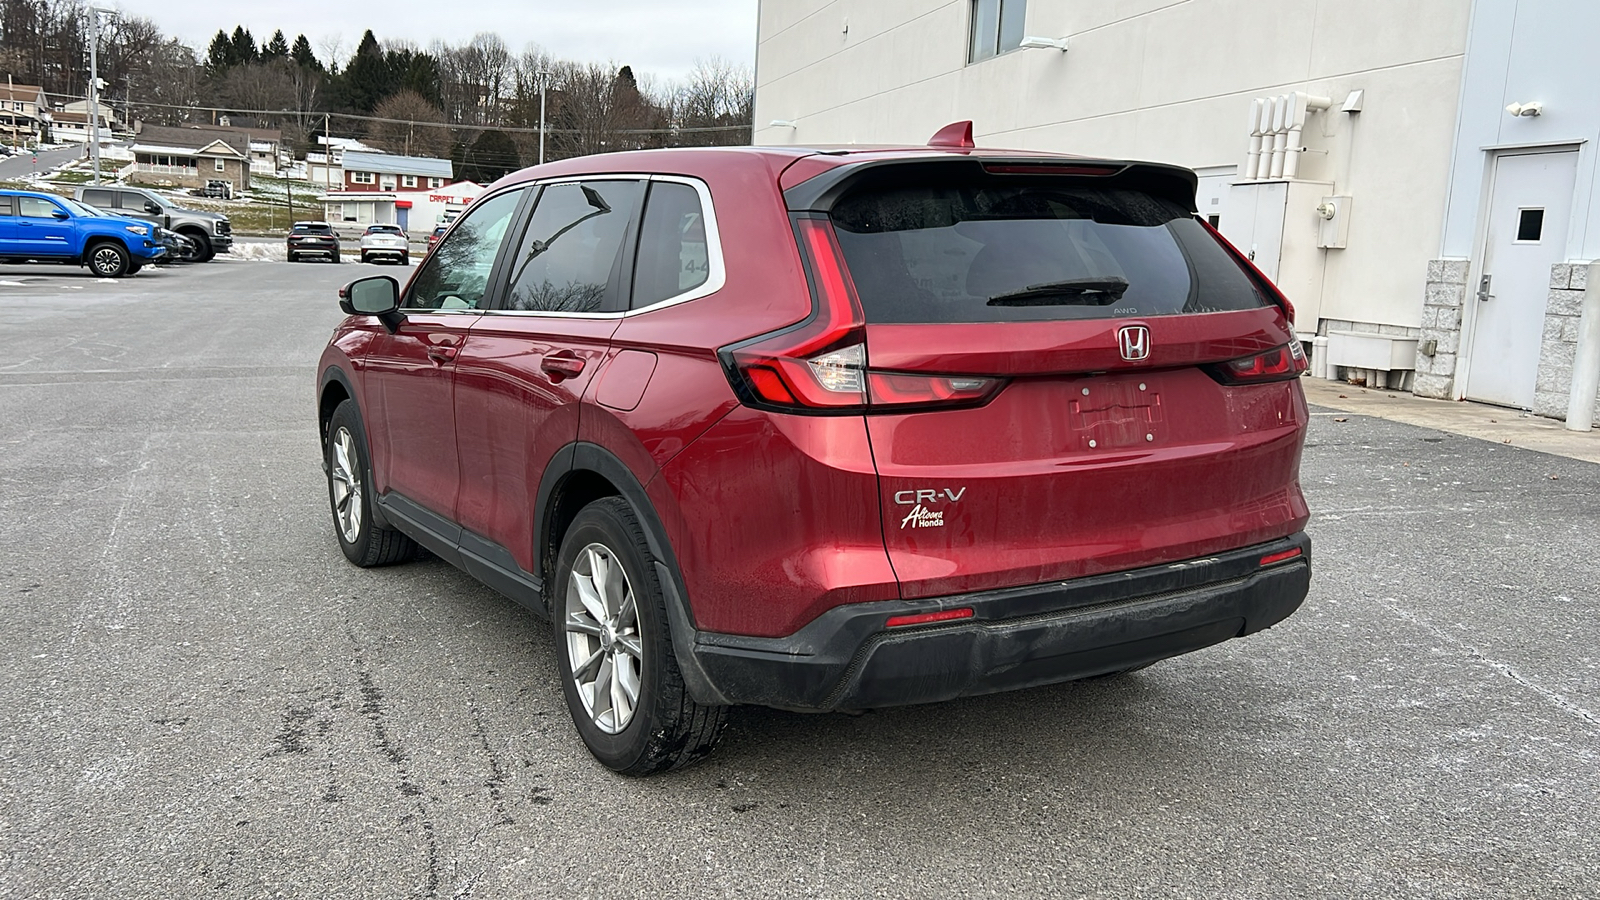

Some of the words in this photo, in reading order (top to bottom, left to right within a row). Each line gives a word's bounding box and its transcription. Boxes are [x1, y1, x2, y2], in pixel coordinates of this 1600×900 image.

[429, 195, 454, 204] CARPET
[1114, 307, 1138, 315] AWD
[894, 486, 966, 505] CR-V
[901, 504, 943, 529] Altoona
[919, 519, 944, 528] Honda
